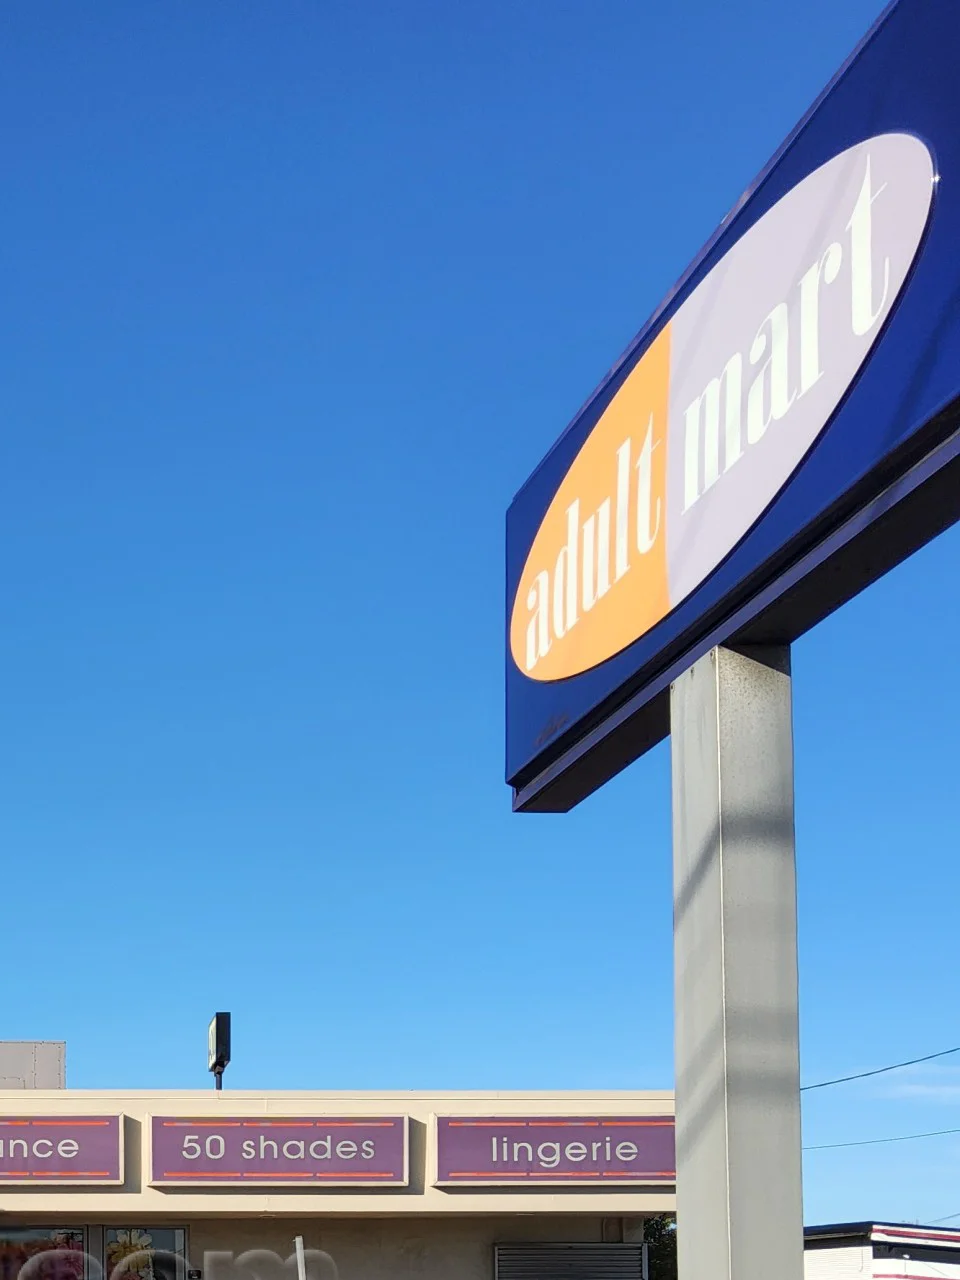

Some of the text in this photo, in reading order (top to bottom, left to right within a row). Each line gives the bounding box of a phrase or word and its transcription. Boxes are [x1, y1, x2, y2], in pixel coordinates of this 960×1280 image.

[524, 152, 890, 671] adult mart
[181, 1134, 376, 1160] 50 shades
[491, 1136, 638, 1168] lingerie
